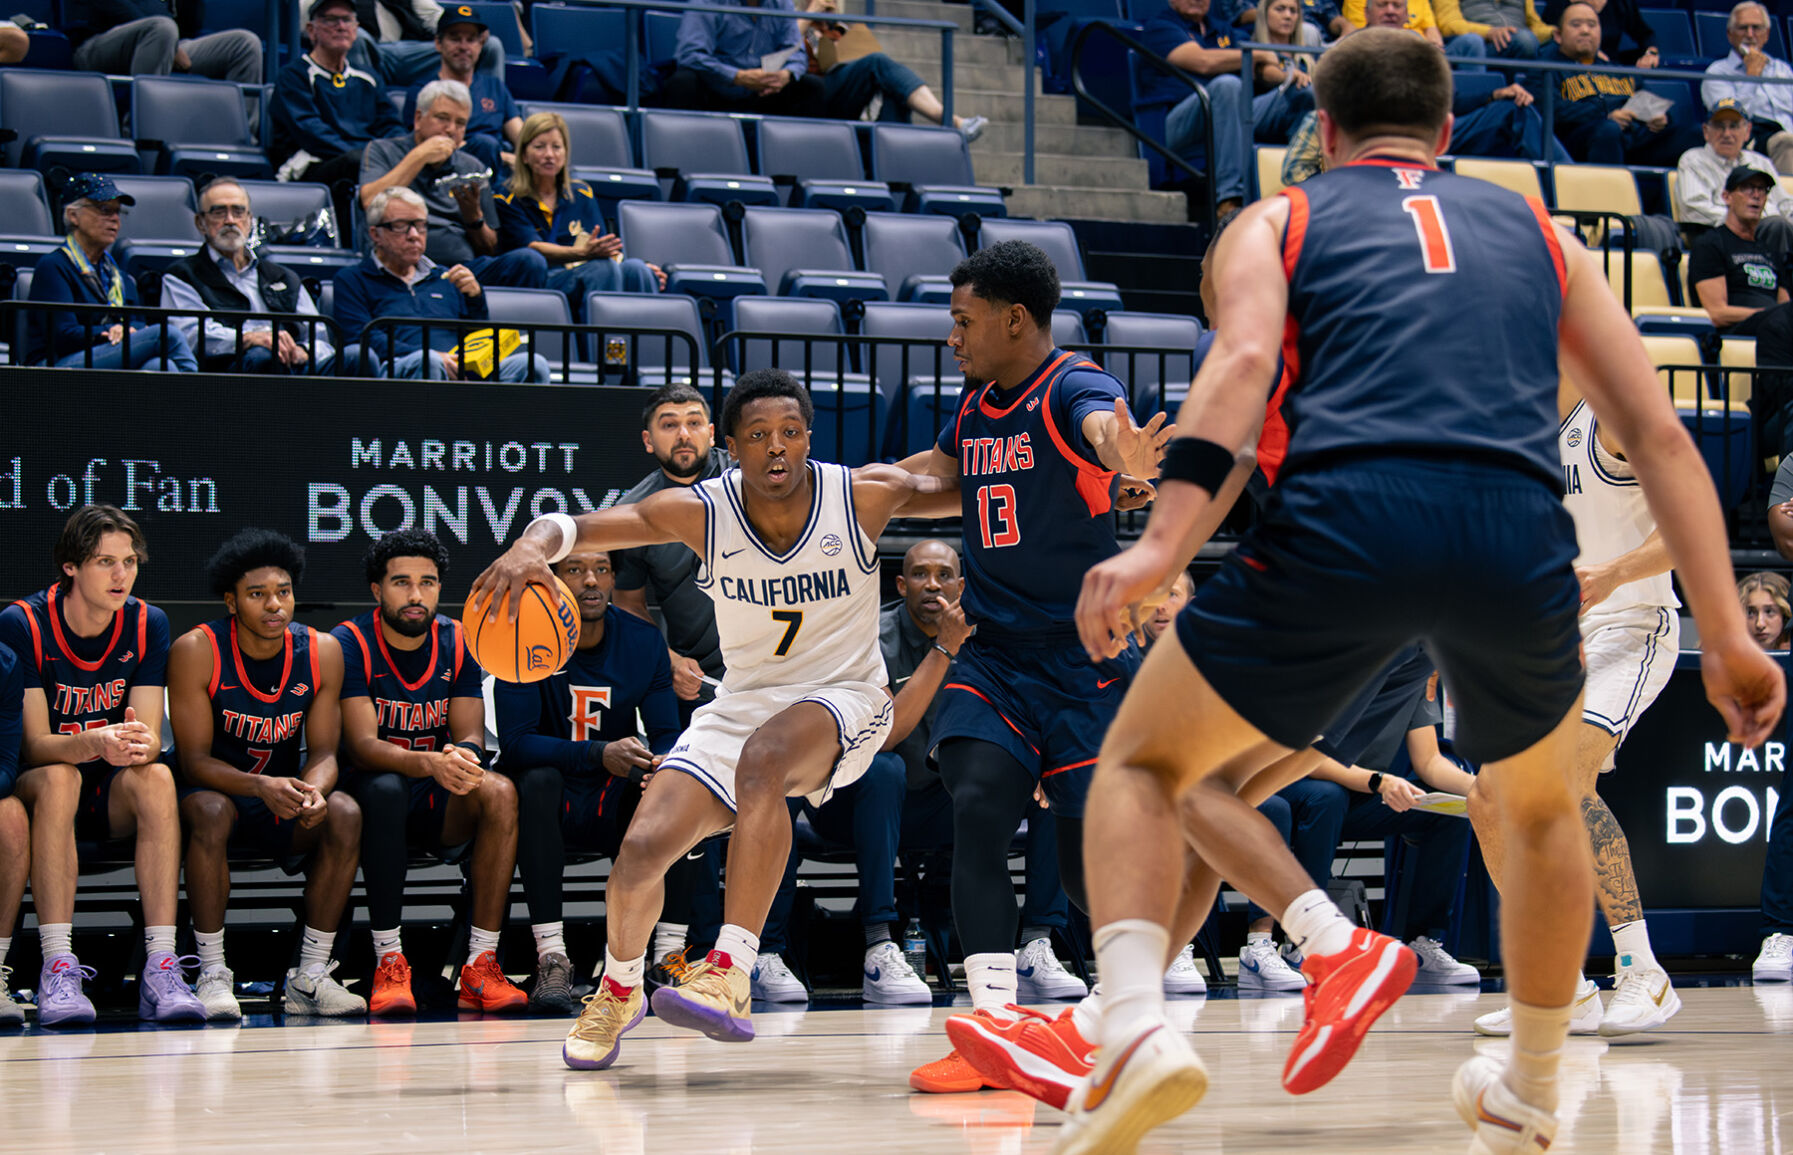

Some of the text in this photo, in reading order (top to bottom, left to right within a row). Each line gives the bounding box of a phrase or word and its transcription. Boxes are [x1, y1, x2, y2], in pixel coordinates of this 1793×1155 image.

[332, 73, 346, 88] C
[1391, 167, 1424, 189] F
[1402, 195, 1456, 273] 1
[351, 437, 580, 473] MARRIOTT
[962, 432, 1034, 475] TITANS
[47, 458, 107, 512] of
[120, 458, 220, 512] Fan
[977, 484, 1021, 548] 13
[720, 568, 850, 607] CALIFORNIA
[771, 609, 803, 656] 7
[526, 645, 553, 672] Cal
[54, 679, 126, 715] TITANS
[375, 697, 449, 731] TITANS
[567, 684, 611, 742] F
[222, 709, 303, 744] TITANS
[247, 747, 273, 775] 7
